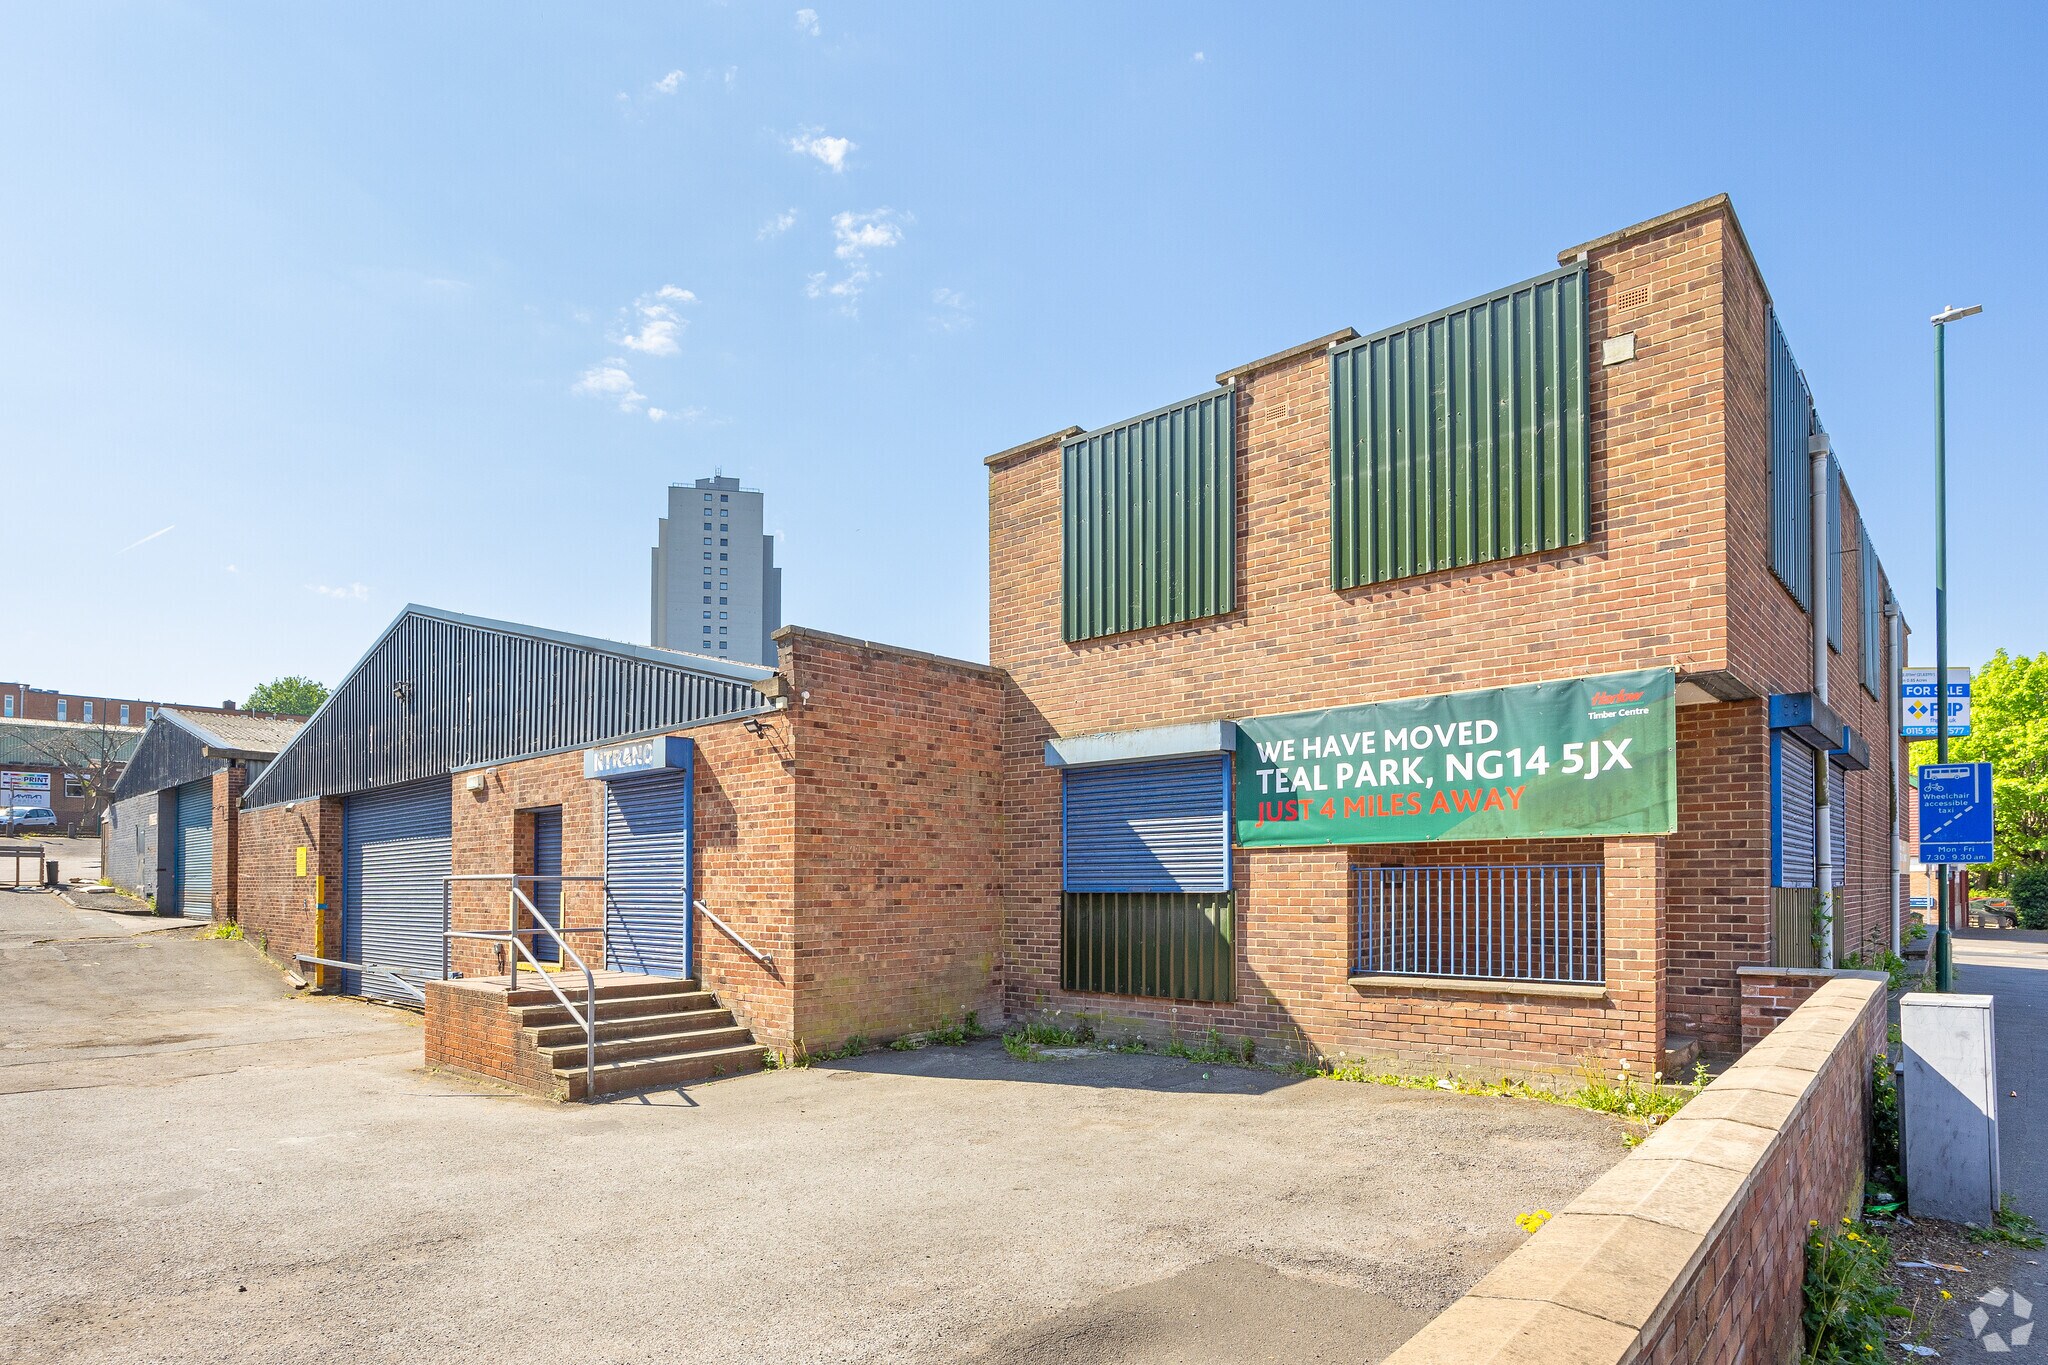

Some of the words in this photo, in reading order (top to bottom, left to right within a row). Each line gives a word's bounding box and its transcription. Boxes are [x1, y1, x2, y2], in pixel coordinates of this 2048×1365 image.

[1906, 686, 1931, 696] FOR
[1588, 711, 1618, 720] Timber
[1618, 708, 1650, 717] Centre
[1257, 739, 1296, 763] WE
[1303, 731, 1376, 760] HAVE
[1384, 719, 1499, 753] MOVED
[1906, 727, 1924, 735] 0115
[1256, 765, 1328, 794] TEAL
[1336, 756, 1434, 790] PARK,
[1446, 745, 1550, 782] NG14
[1561, 738, 1633, 780] 5JX
[1255, 799, 1314, 828] JUST
[1320, 797, 1336, 819] 4
[1343, 792, 1422, 818] MILES
[1429, 785, 1526, 814] AWAY
